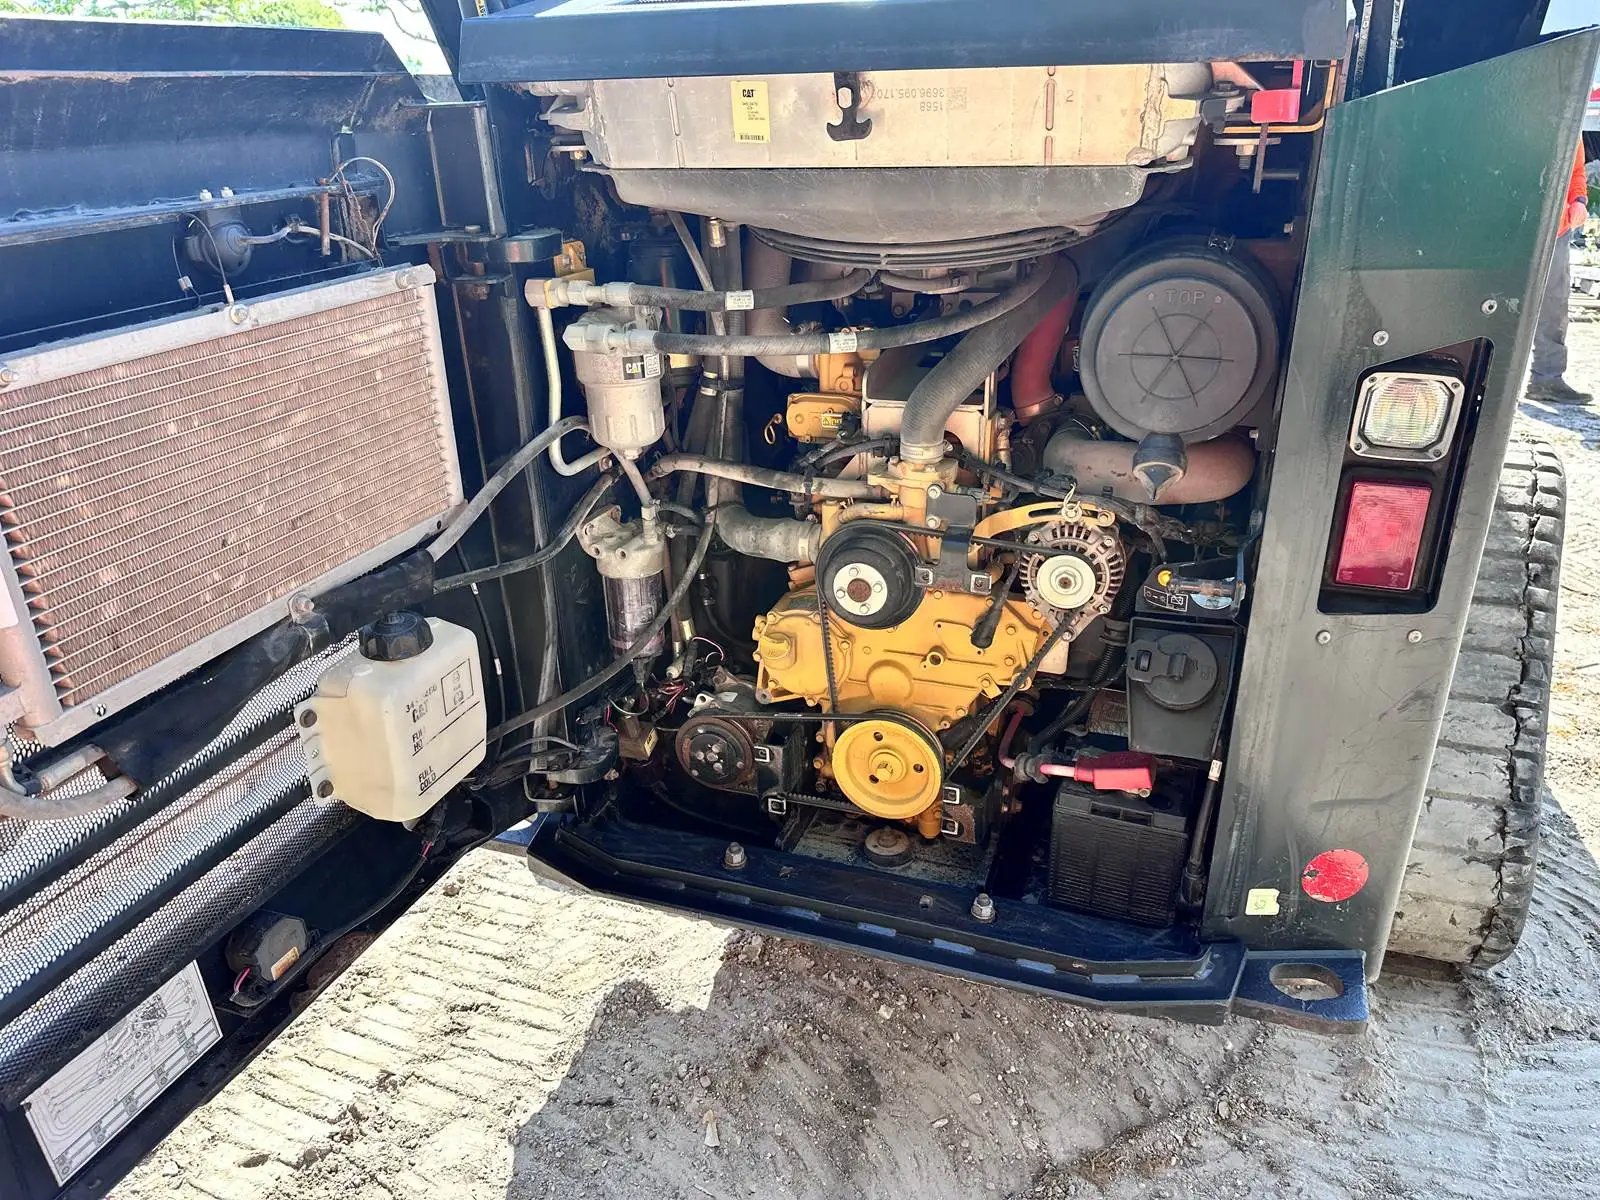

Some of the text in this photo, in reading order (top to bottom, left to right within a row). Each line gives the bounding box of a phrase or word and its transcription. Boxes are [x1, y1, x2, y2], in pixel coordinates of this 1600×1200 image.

[742, 88, 755, 98] CAT
[1065, 89, 1075, 103] 2
[1165, 288, 1206, 305] TOP
[625, 362, 642, 374] CAT
[413, 737, 425, 752] HO
[418, 765, 434, 783] FULL
[419, 772, 437, 791] COLD
